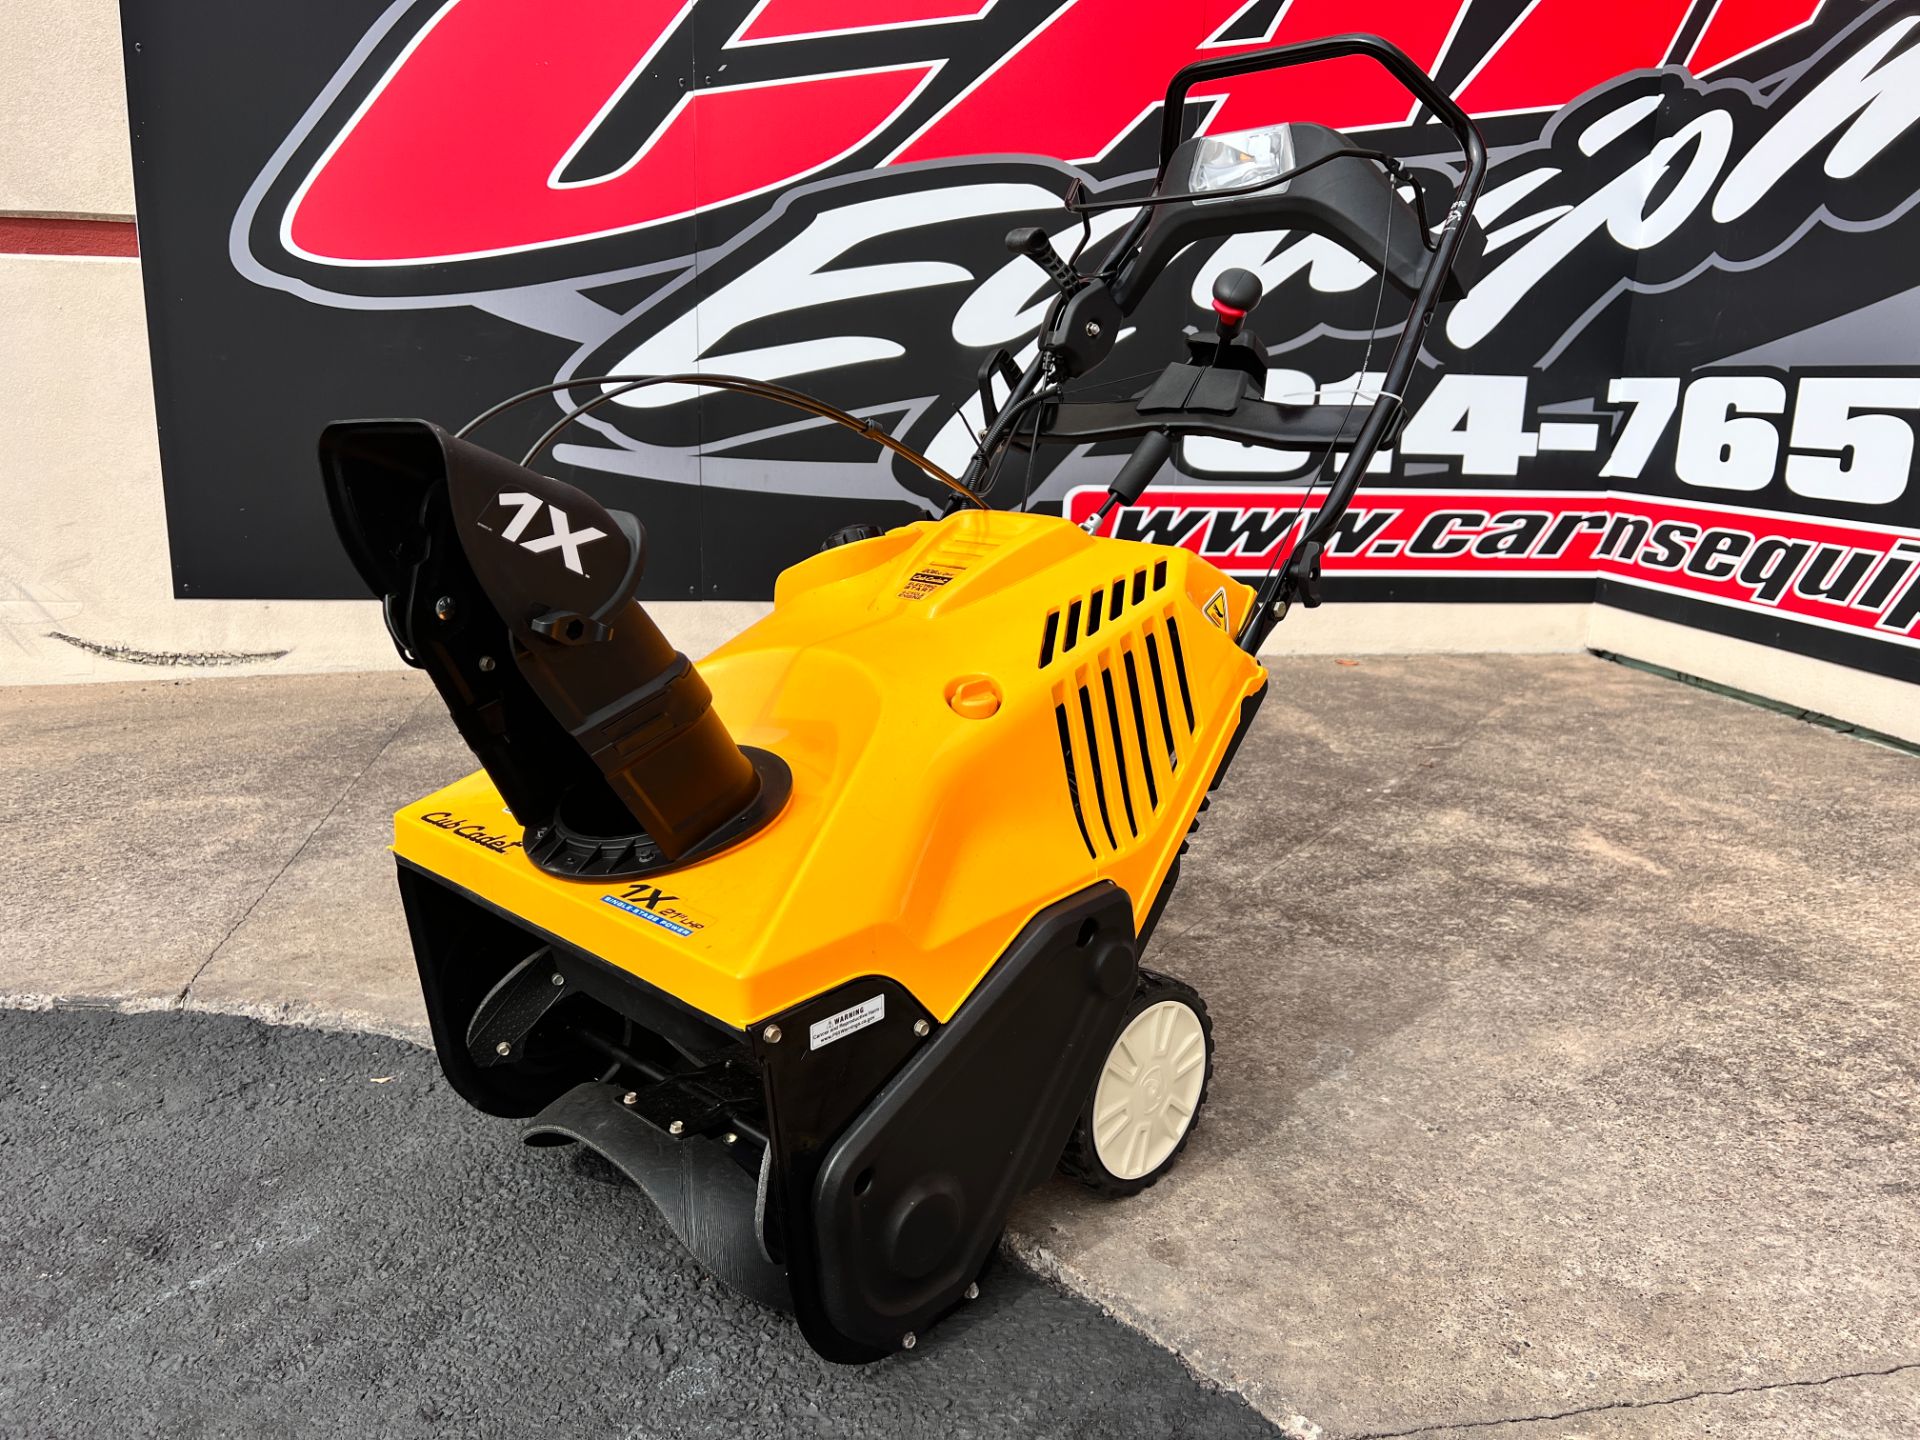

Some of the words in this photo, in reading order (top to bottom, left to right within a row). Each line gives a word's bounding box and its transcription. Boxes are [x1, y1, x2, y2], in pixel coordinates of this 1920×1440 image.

[498, 492, 608, 575] 1X
[420, 812, 467, 829] Cub
[453, 825, 523, 854] Cadet
[620, 884, 680, 910] 1X
[659, 920, 691, 936] POWER
[834, 1006, 864, 1025] WARNING
